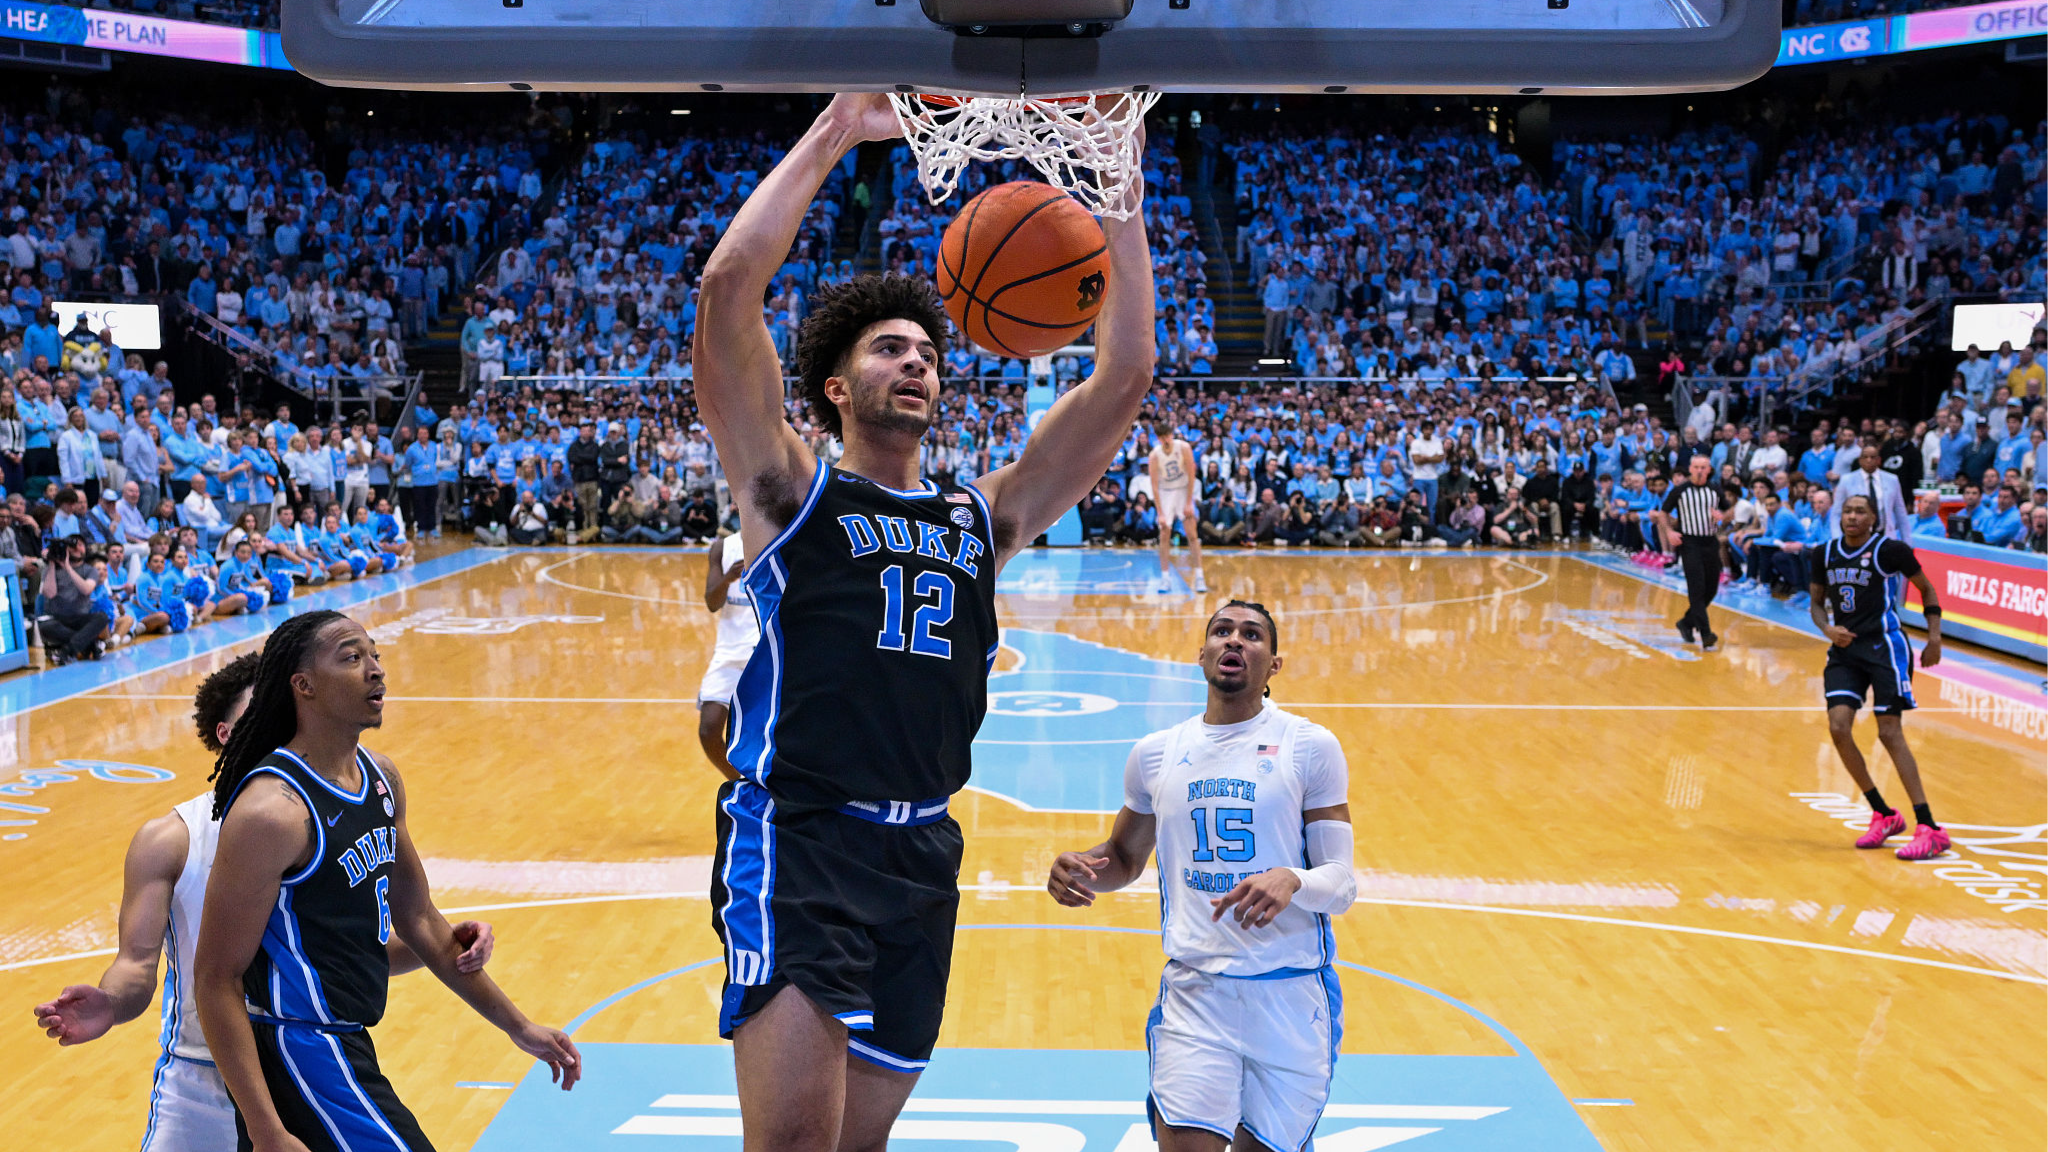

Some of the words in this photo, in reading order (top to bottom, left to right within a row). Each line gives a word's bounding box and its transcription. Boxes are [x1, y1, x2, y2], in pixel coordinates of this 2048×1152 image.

[114, 22, 166, 45] PLAN
[837, 513, 985, 580] DUKE
[1826, 567, 1873, 587] DUKE
[1946, 569, 1999, 607] WELLS
[877, 564, 956, 660] 12
[1839, 585, 1856, 613] 3
[1188, 778, 1256, 802] NORTH
[884, 799, 912, 824] D
[1190, 807, 1256, 862] 15
[375, 875, 392, 945] 6
[735, 948, 761, 986] D
